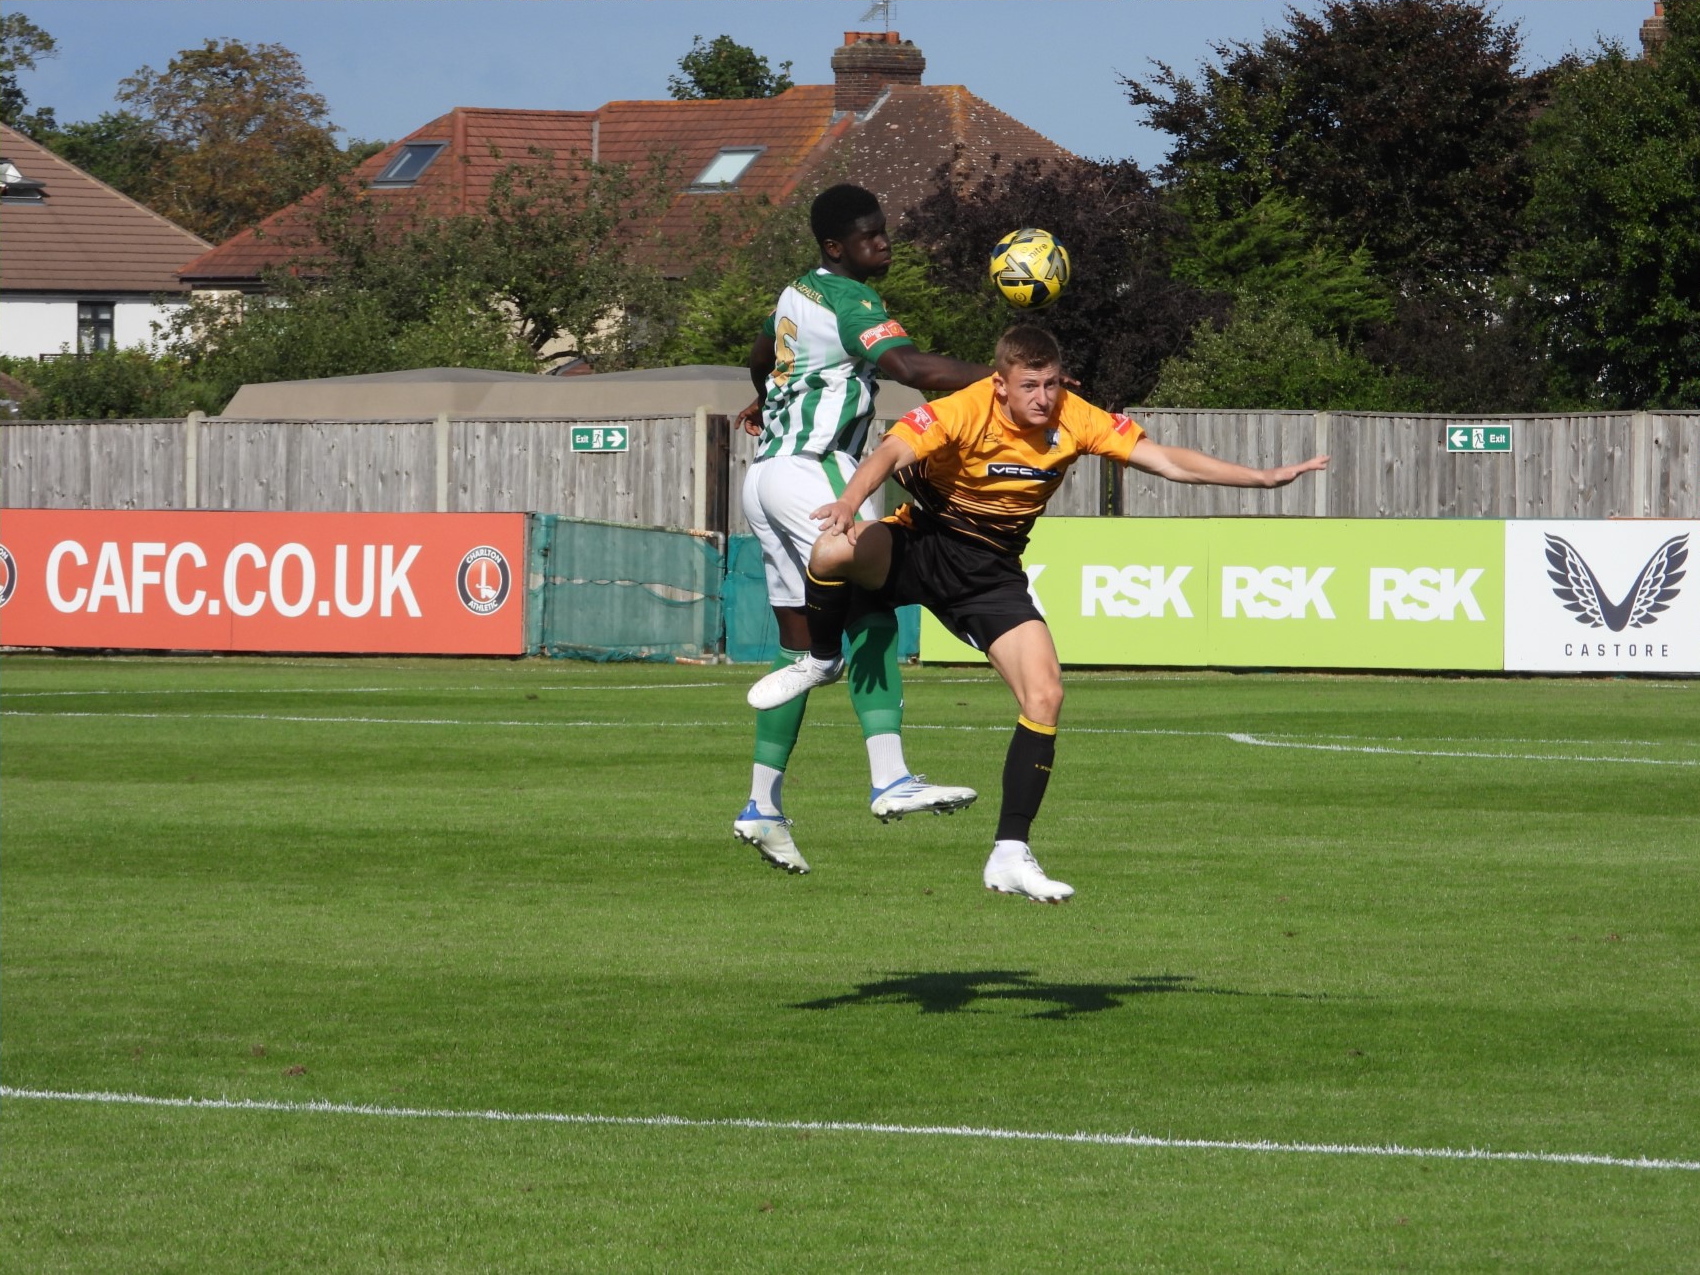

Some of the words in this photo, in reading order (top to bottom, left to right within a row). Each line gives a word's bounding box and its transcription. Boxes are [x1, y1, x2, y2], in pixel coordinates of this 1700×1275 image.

[1028, 243, 1048, 261] mitre
[575, 434, 589, 443] Exit
[1489, 434, 1506, 443] Exit
[465, 548, 502, 565] CHARLTON
[44, 539, 423, 618] CAFC.CO.UK
[1081, 564, 1195, 618] RSK
[1221, 565, 1336, 620] RSK
[1368, 567, 1487, 621] RSK
[467, 600, 499, 612] ATHLETIC
[1564, 643, 1671, 657] CASTORE
